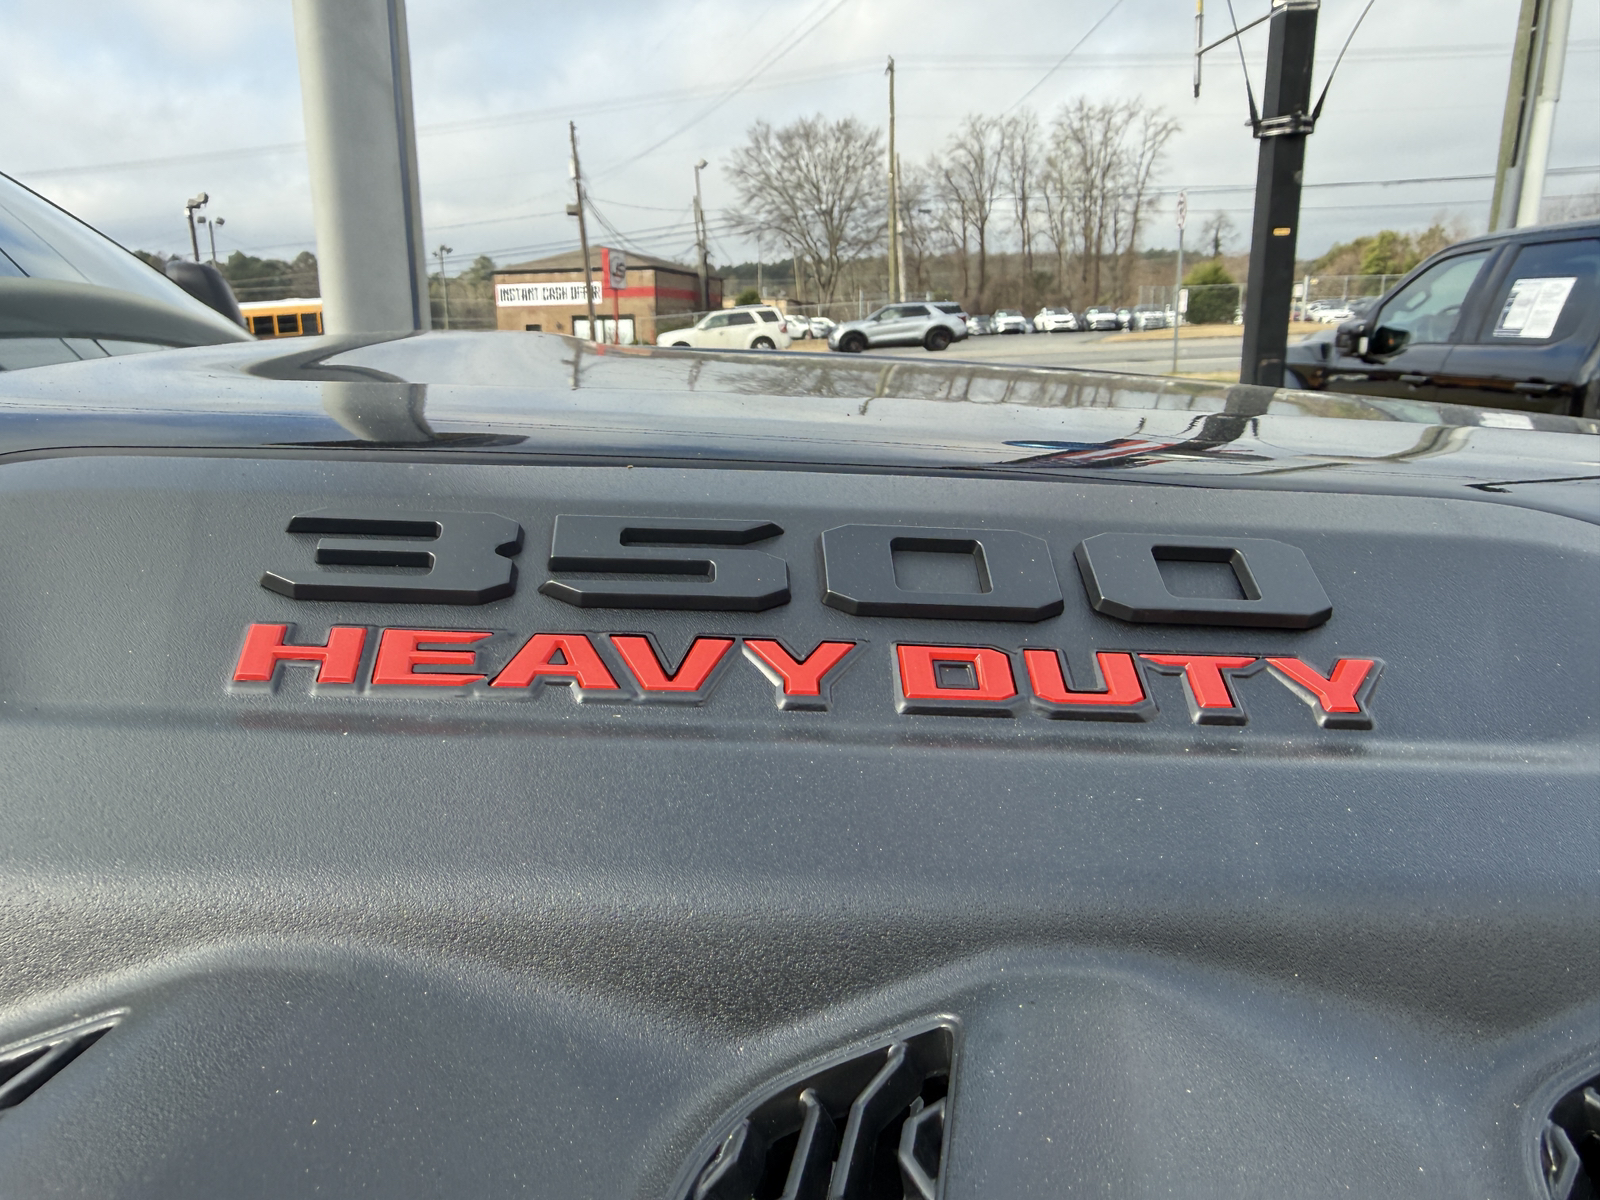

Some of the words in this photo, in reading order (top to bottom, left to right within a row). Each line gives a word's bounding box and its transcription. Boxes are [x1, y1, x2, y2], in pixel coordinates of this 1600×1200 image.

[500, 287, 539, 302] INSTANT
[542, 286, 568, 301] CASH
[570, 285, 601, 300] OFFR
[260, 506, 1333, 630] 3500
[230, 622, 862, 708] HEAVY
[893, 641, 1382, 728] DUTY
